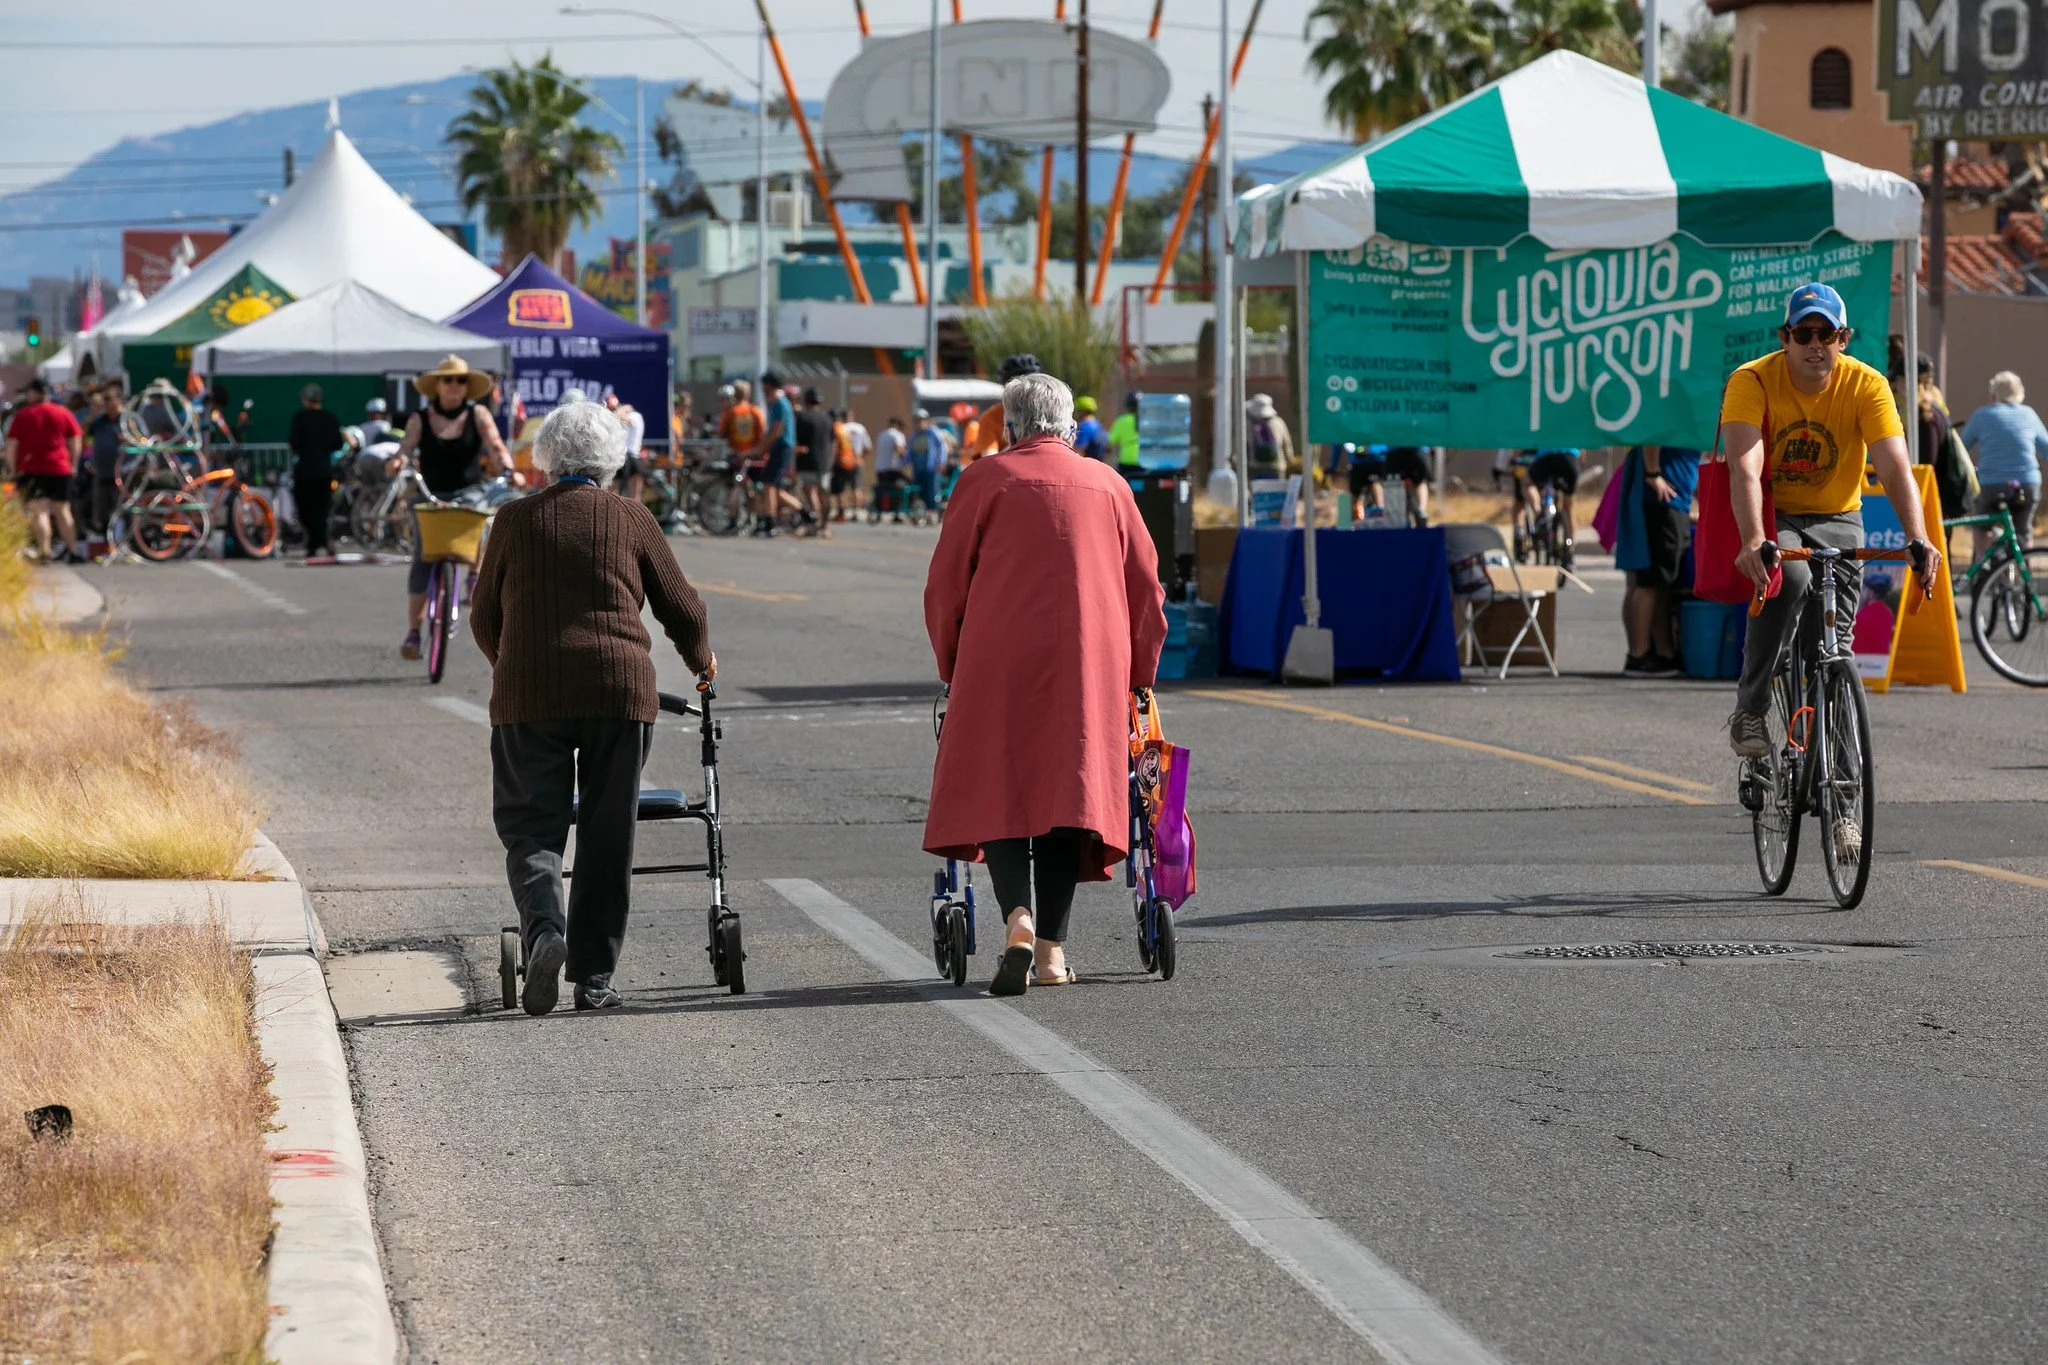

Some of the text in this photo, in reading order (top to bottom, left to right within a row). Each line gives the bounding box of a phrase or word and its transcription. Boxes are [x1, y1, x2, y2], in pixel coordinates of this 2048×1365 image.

[1896, 0, 2048, 76] MO
[1913, 83, 1963, 110] AIR
[1729, 242, 1874, 283] CAR-FREE CITY STREETS
[1356, 272, 1400, 285] streets
[1728, 282, 1753, 300] FOR
[1726, 301, 1753, 318] AND
[1343, 397, 1450, 414] CYCLOVIA TUCSON
